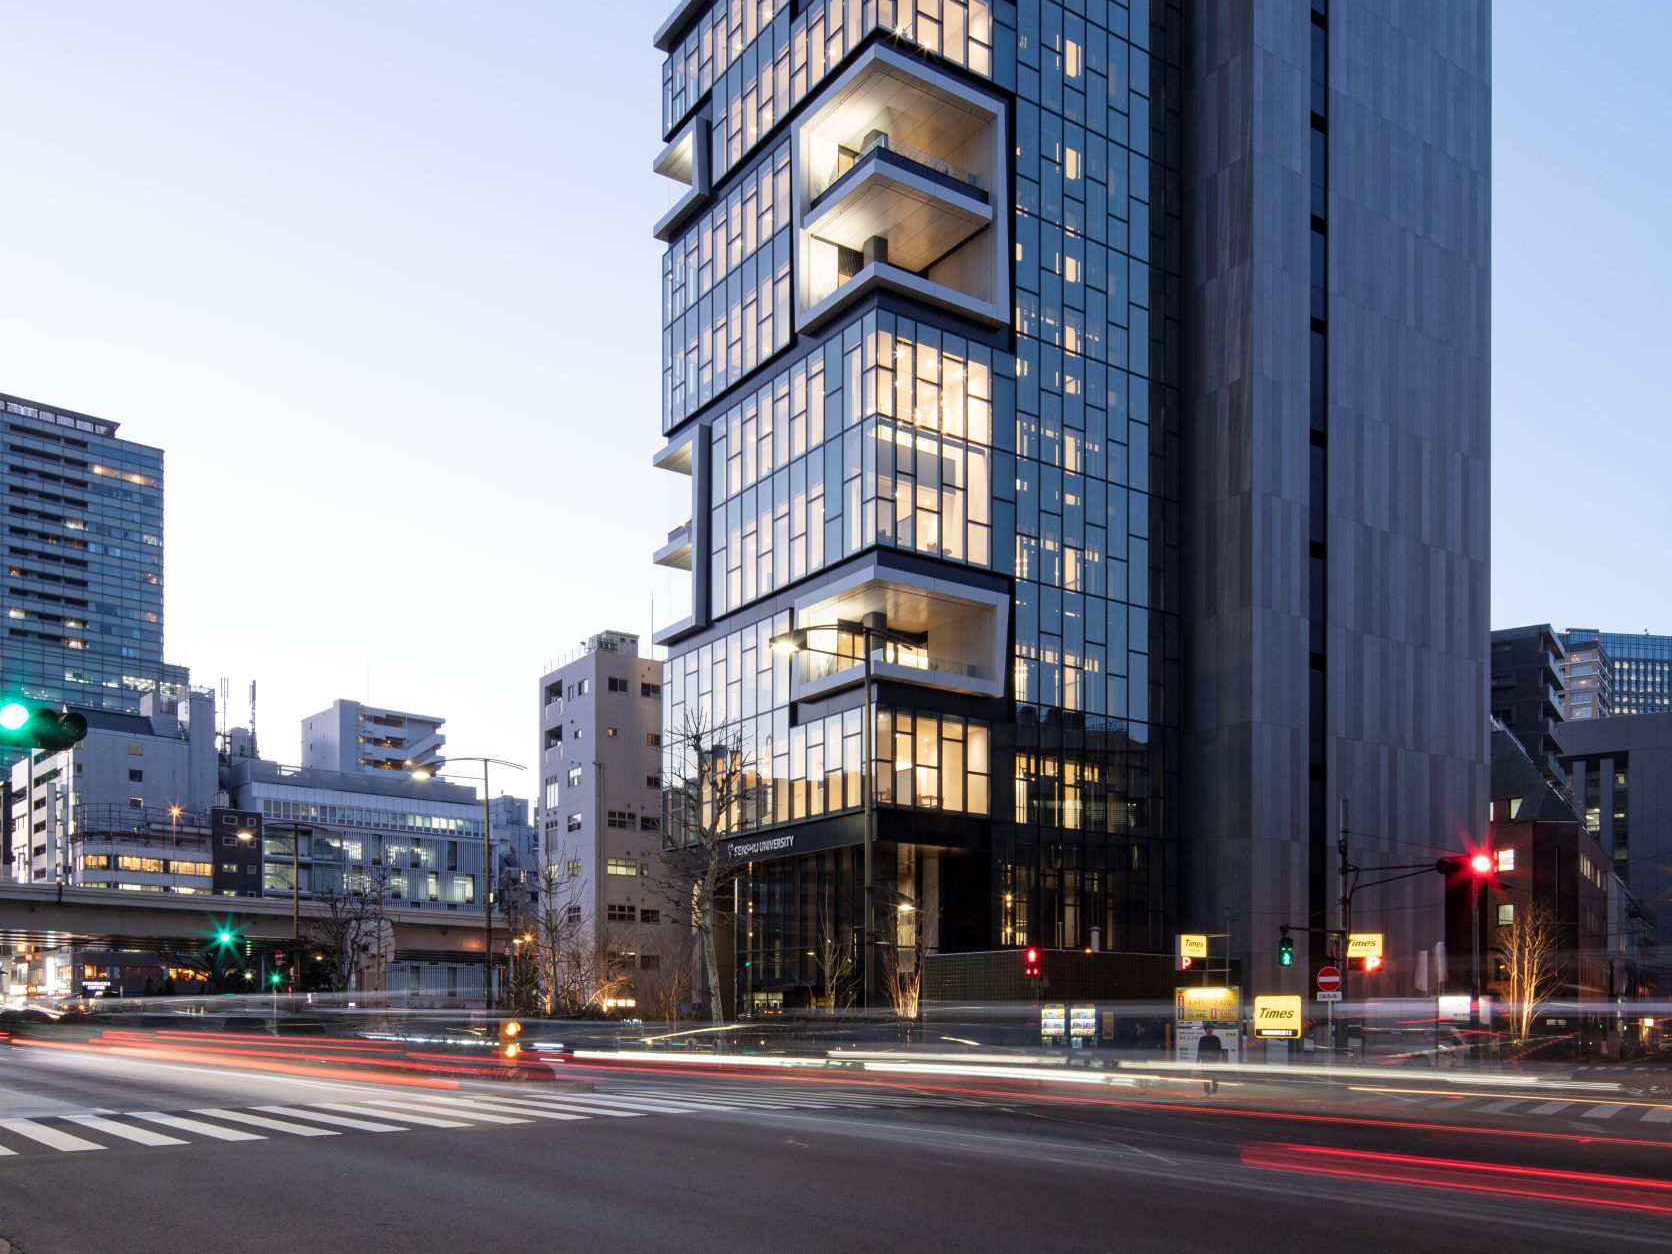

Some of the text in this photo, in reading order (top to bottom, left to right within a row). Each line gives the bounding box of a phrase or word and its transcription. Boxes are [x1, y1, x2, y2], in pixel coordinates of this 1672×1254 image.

[734, 835, 794, 857] SENSHU UNIVERSITY
[1185, 939, 1204, 947] Times
[1182, 956, 1192, 970] P
[1366, 956, 1381, 971] P
[1259, 1007, 1295, 1019] Times
